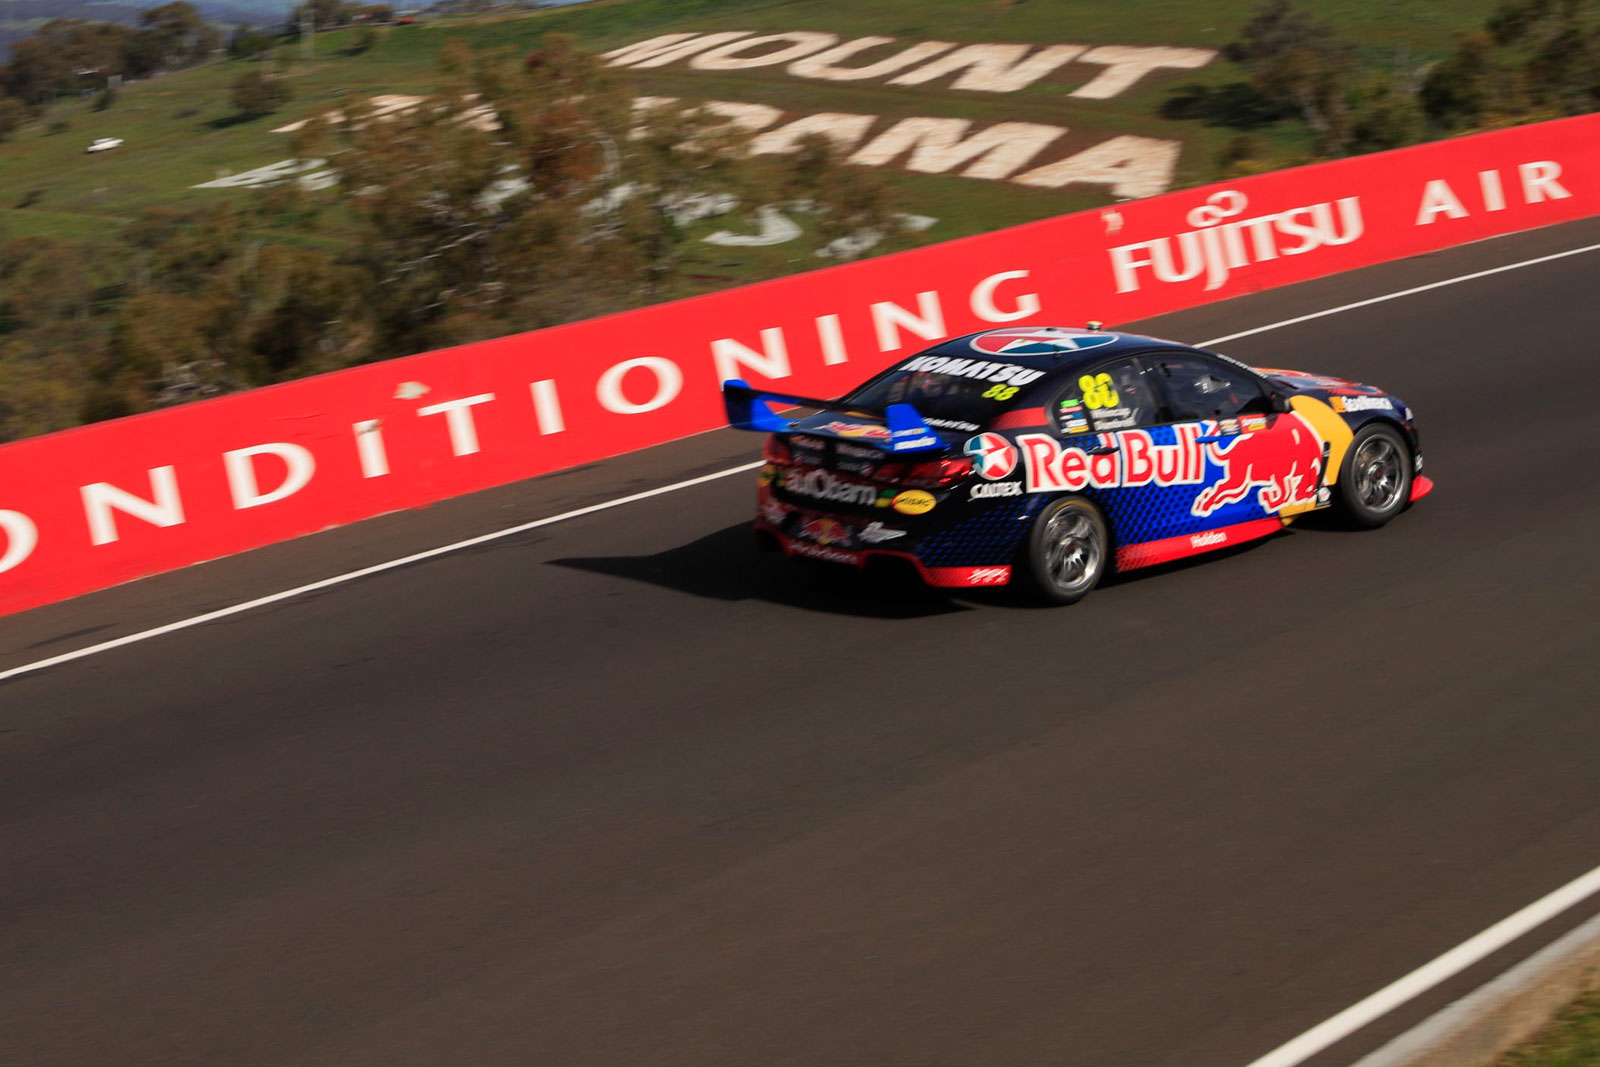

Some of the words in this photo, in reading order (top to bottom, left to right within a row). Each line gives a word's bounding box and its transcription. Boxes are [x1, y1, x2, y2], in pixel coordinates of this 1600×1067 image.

[599, 31, 1217, 99] MOUNT
[1108, 196, 1365, 293] FUJITSU
[1416, 160, 1573, 225] AIR
[900, 355, 1048, 387] KOMATSU
[980, 384, 1021, 402] 88
[922, 417, 981, 432] OMATSU
[1016, 432, 1122, 494] Red
[1116, 421, 1206, 489] Bull
[967, 480, 1023, 502] CALTEX
[1190, 530, 1228, 549] Holden
